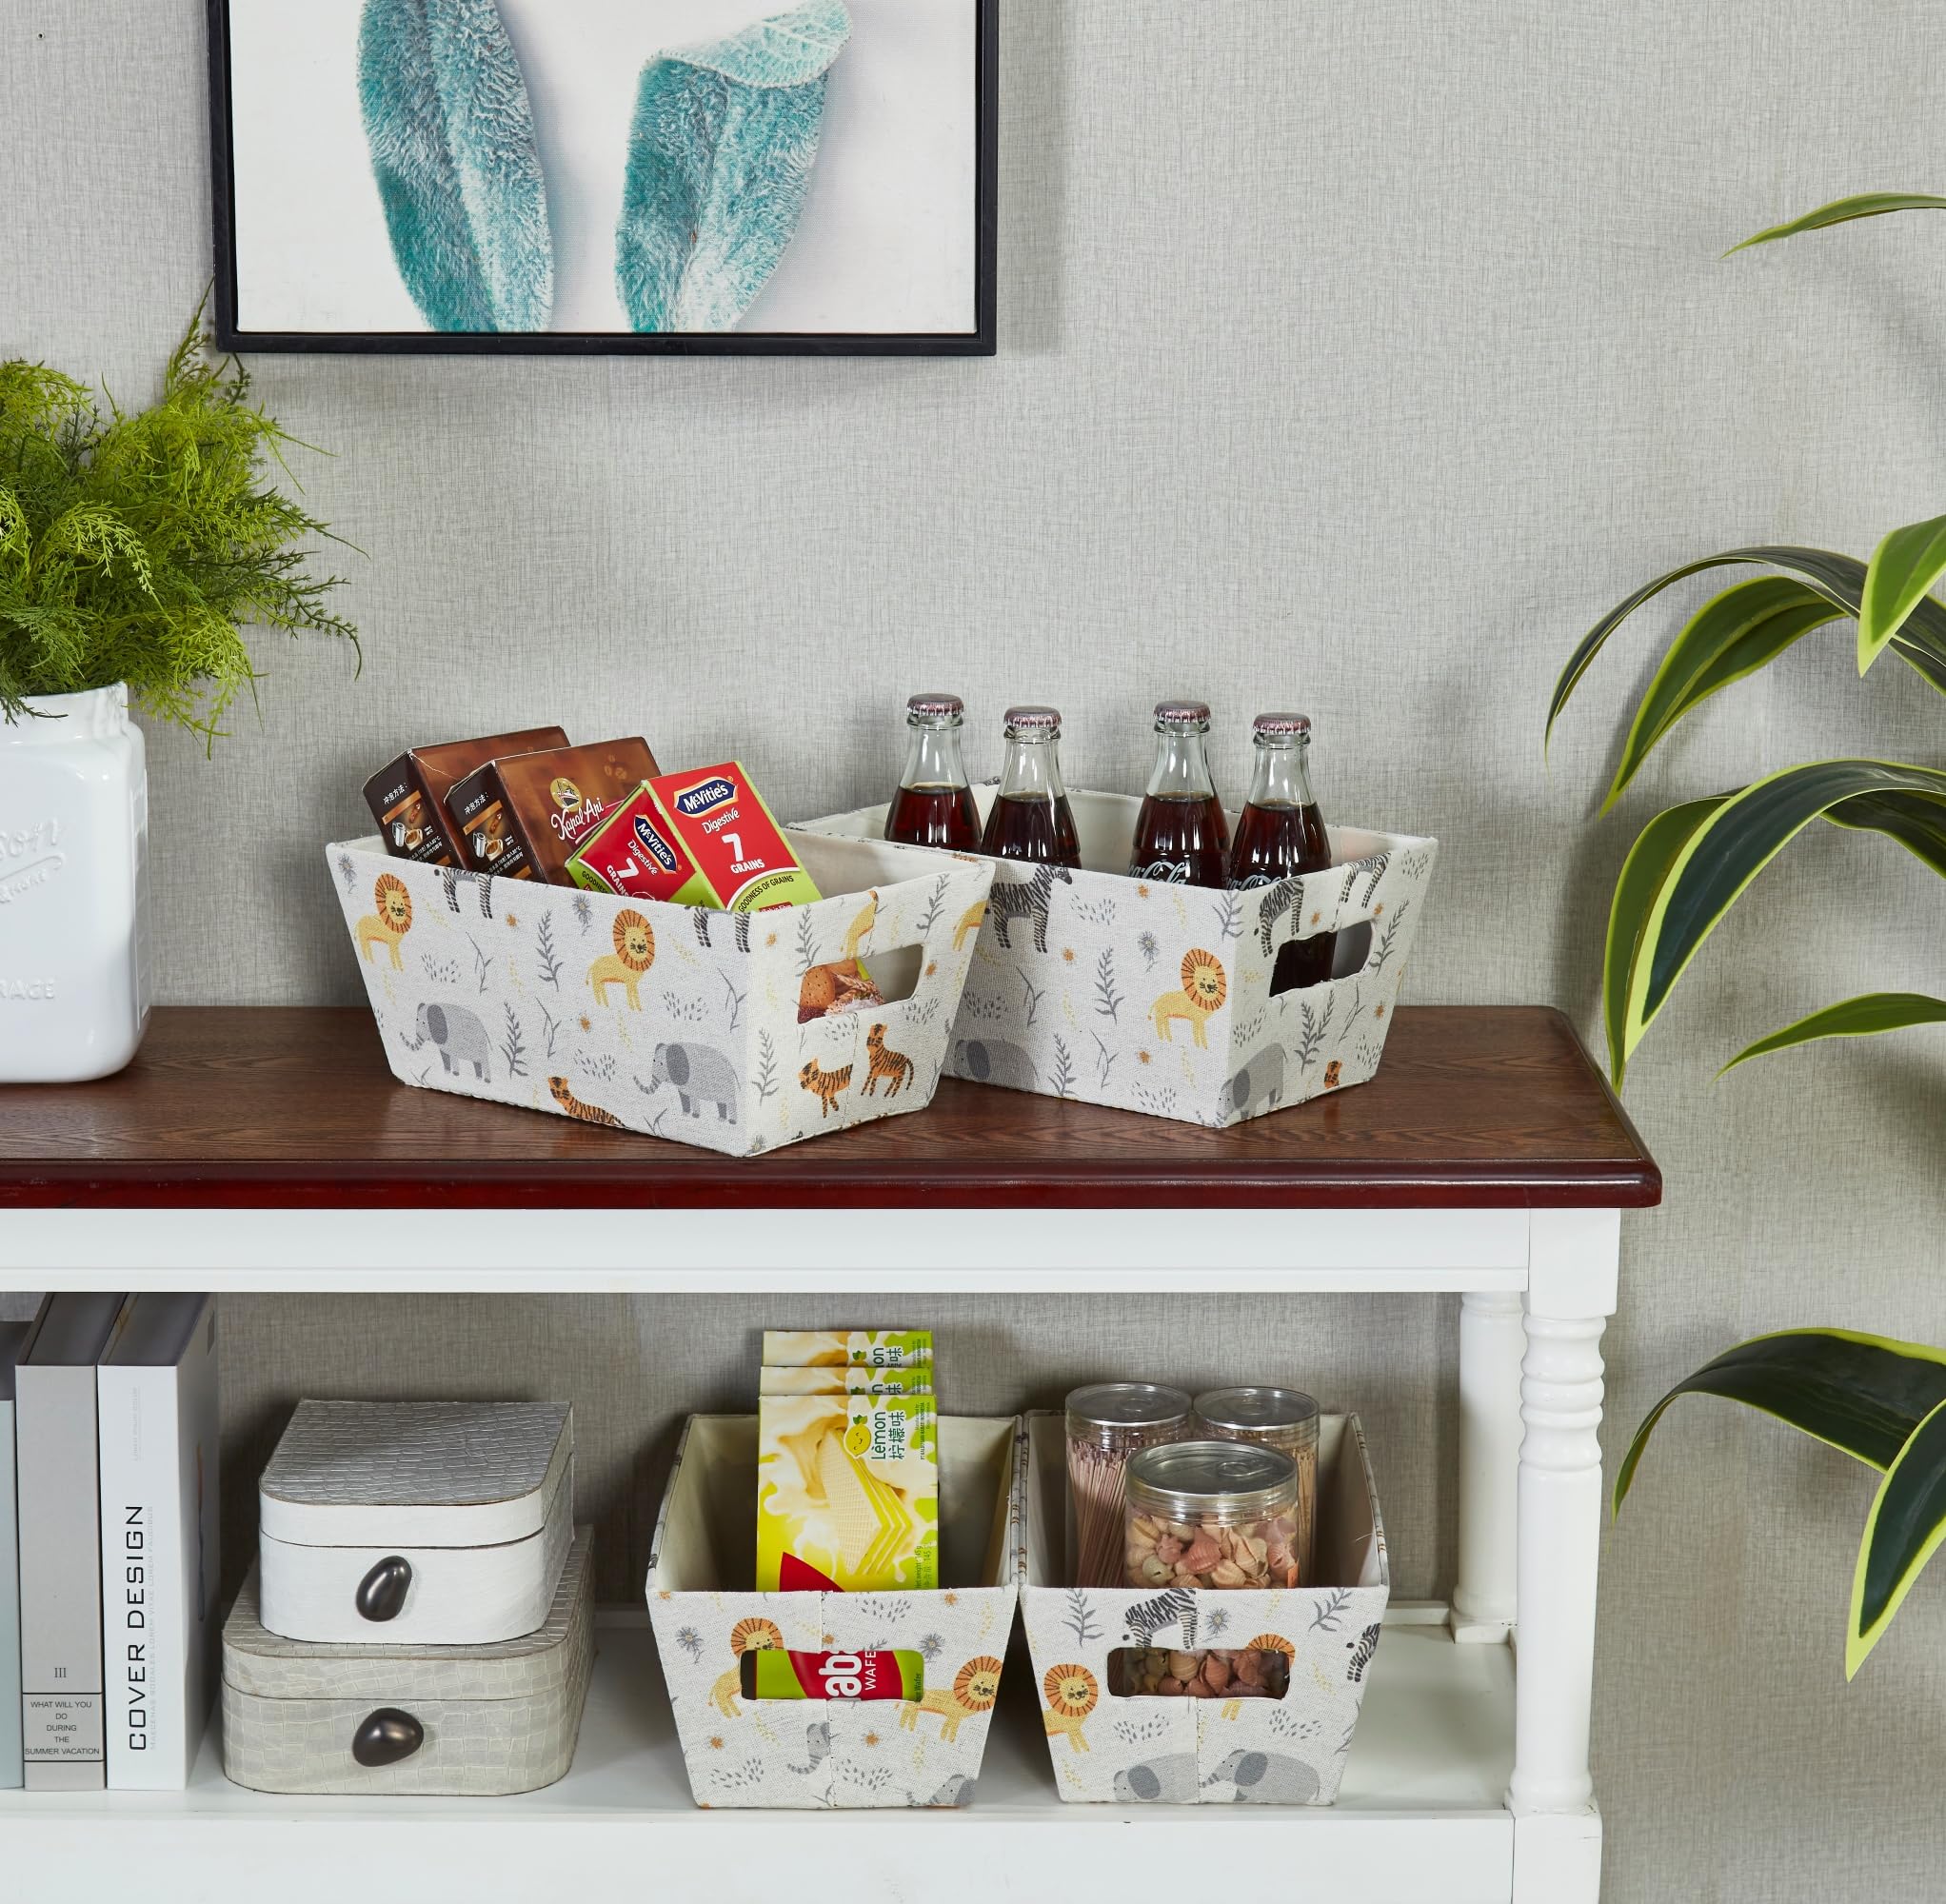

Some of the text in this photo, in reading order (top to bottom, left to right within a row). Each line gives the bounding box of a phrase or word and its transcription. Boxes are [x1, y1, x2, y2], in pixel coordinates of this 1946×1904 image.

[683, 783, 729, 812] McVitie's
[550, 797, 605, 841] Kapal Api
[701, 807, 740, 834] Digestive
[626, 839, 658, 875] Digestive
[637, 823, 672, 865] McVitie's
[721, 833, 744, 862] 7
[616, 857, 639, 879] 7
[730, 859, 765, 874] GRAINS
[738, 886, 764, 912] GOODNESS
[761, 881, 770, 890] OF
[769, 875, 794, 886] GRAINS
[887, 1411, 905, 1460] 柠檬味
[126, 1506, 147, 1750] COVER DESIGN
[54, 1667, 67, 1678] III
[864, 1651, 877, 1691] WAFE
